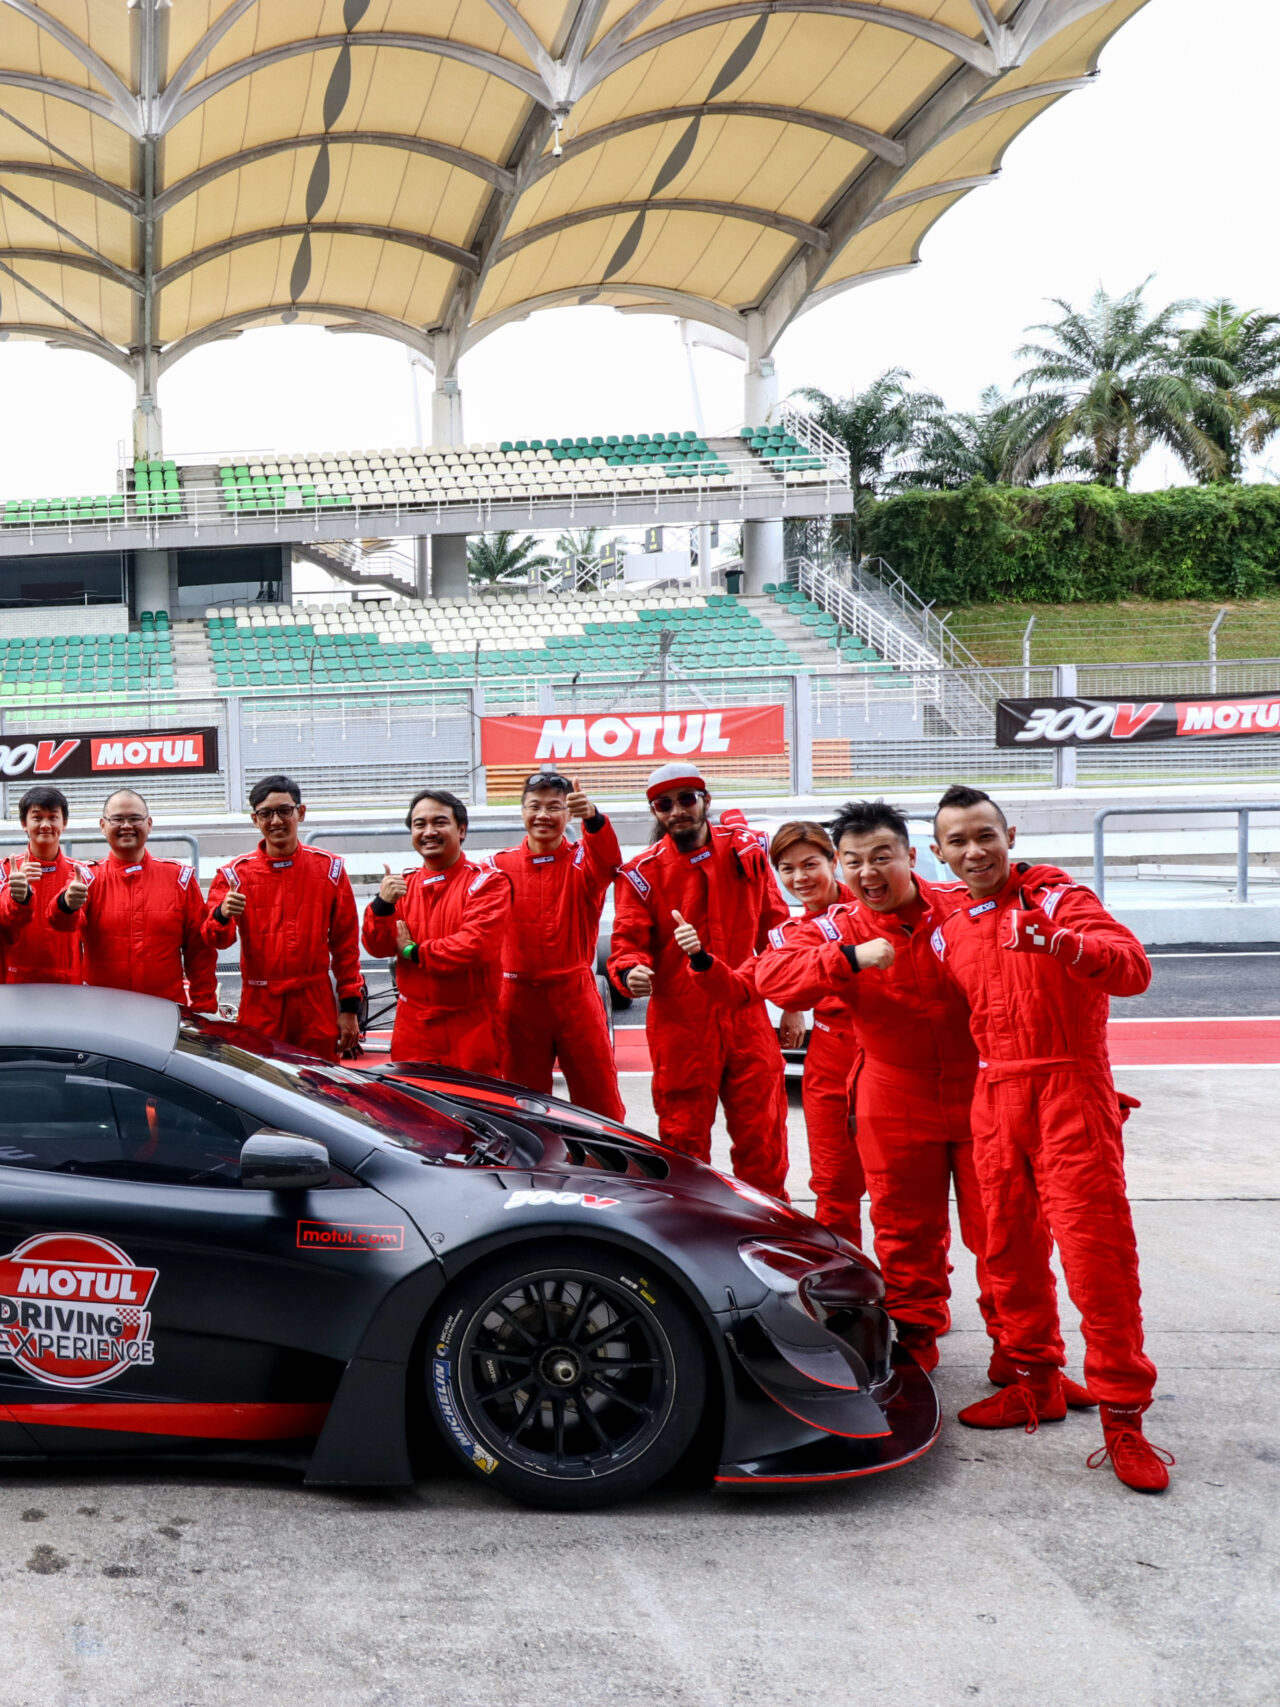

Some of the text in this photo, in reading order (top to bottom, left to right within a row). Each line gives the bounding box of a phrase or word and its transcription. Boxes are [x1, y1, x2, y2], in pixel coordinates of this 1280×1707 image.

[534, 713, 730, 759] MOTUL
[1014, 703, 1280, 742] 300V MOTU
[97, 740, 199, 766] MOTUL
[628, 870, 648, 892] sparco
[969, 901, 997, 917] sparco
[303, 1228, 398, 1245] motul.com
[17, 1267, 137, 1300] MOTUL
[434, 1363, 471, 1447] MICHELIN
